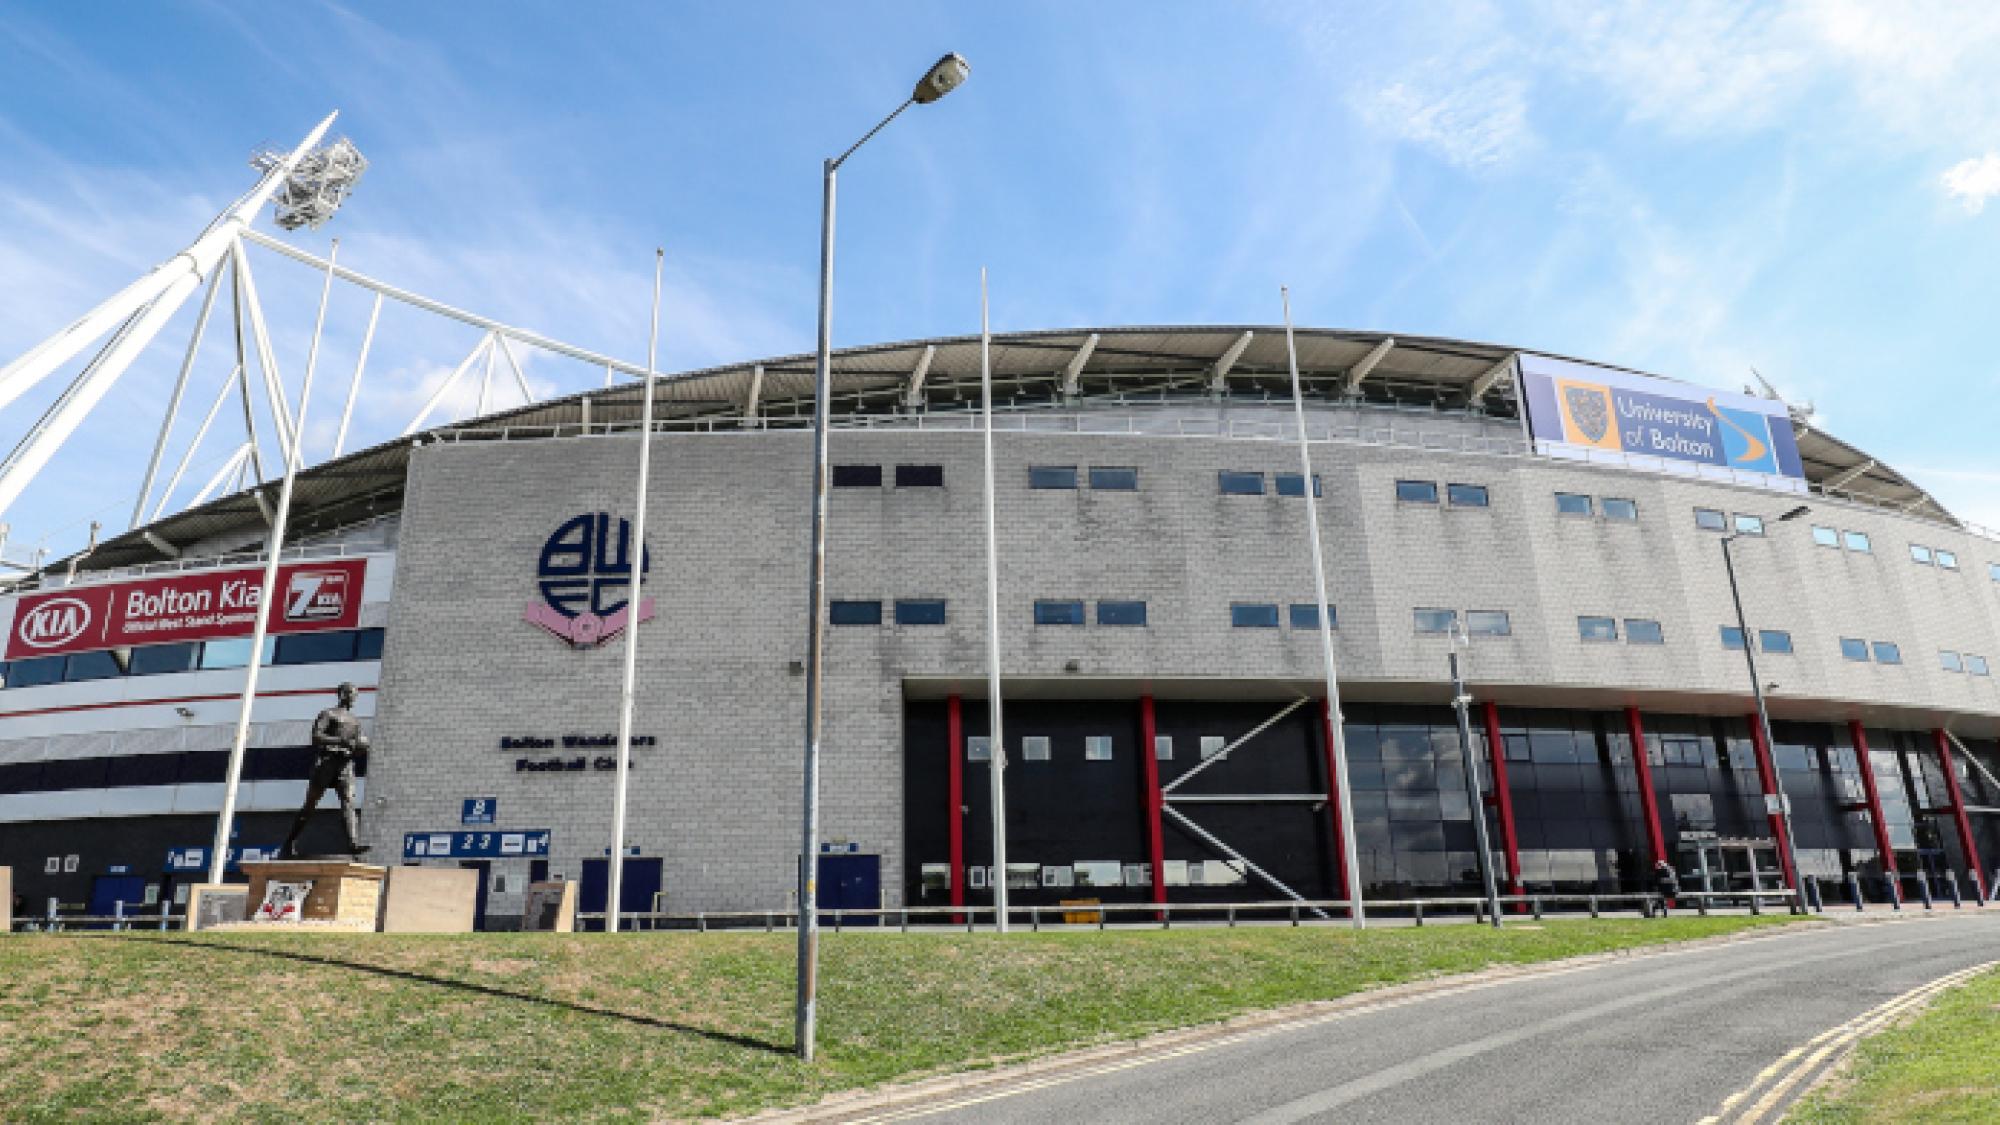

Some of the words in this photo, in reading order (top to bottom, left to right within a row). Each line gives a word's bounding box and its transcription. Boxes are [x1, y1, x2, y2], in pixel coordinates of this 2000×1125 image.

[1617, 396, 1713, 437] University
[1625, 425, 1644, 447] of
[1649, 428, 1714, 458] Bolton
[127, 586, 213, 618] Bolton
[220, 578, 262, 609] Kia
[30, 606, 77, 639] KIA
[501, 735, 554, 749] Bolton
[562, 733, 656, 748] Wandeers
[516, 757, 586, 772] Football
